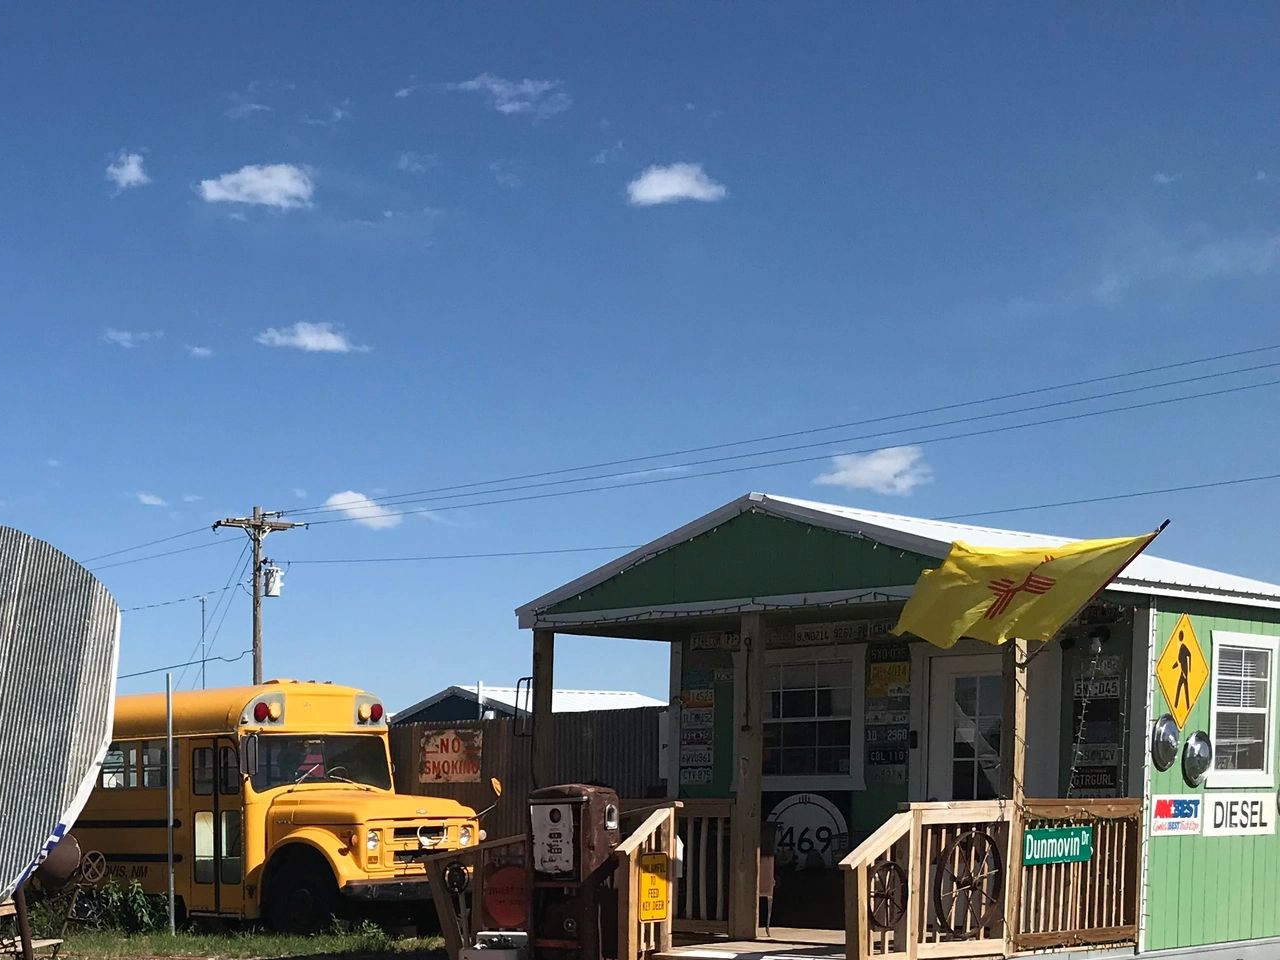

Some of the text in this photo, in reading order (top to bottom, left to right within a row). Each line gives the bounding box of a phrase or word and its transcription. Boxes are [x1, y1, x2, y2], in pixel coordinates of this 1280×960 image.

[440, 737, 461, 753] NO
[424, 759, 480, 775] SMOKING
[1213, 800, 1268, 829] DIESEL
[777, 826, 832, 853] 469
[1025, 830, 1090, 860] Dunmovin Dr
[132, 866, 148, 878] NM
[650, 876, 656, 885] TO
[648, 888, 659, 898] FEED
[652, 900, 664, 911] DEER
